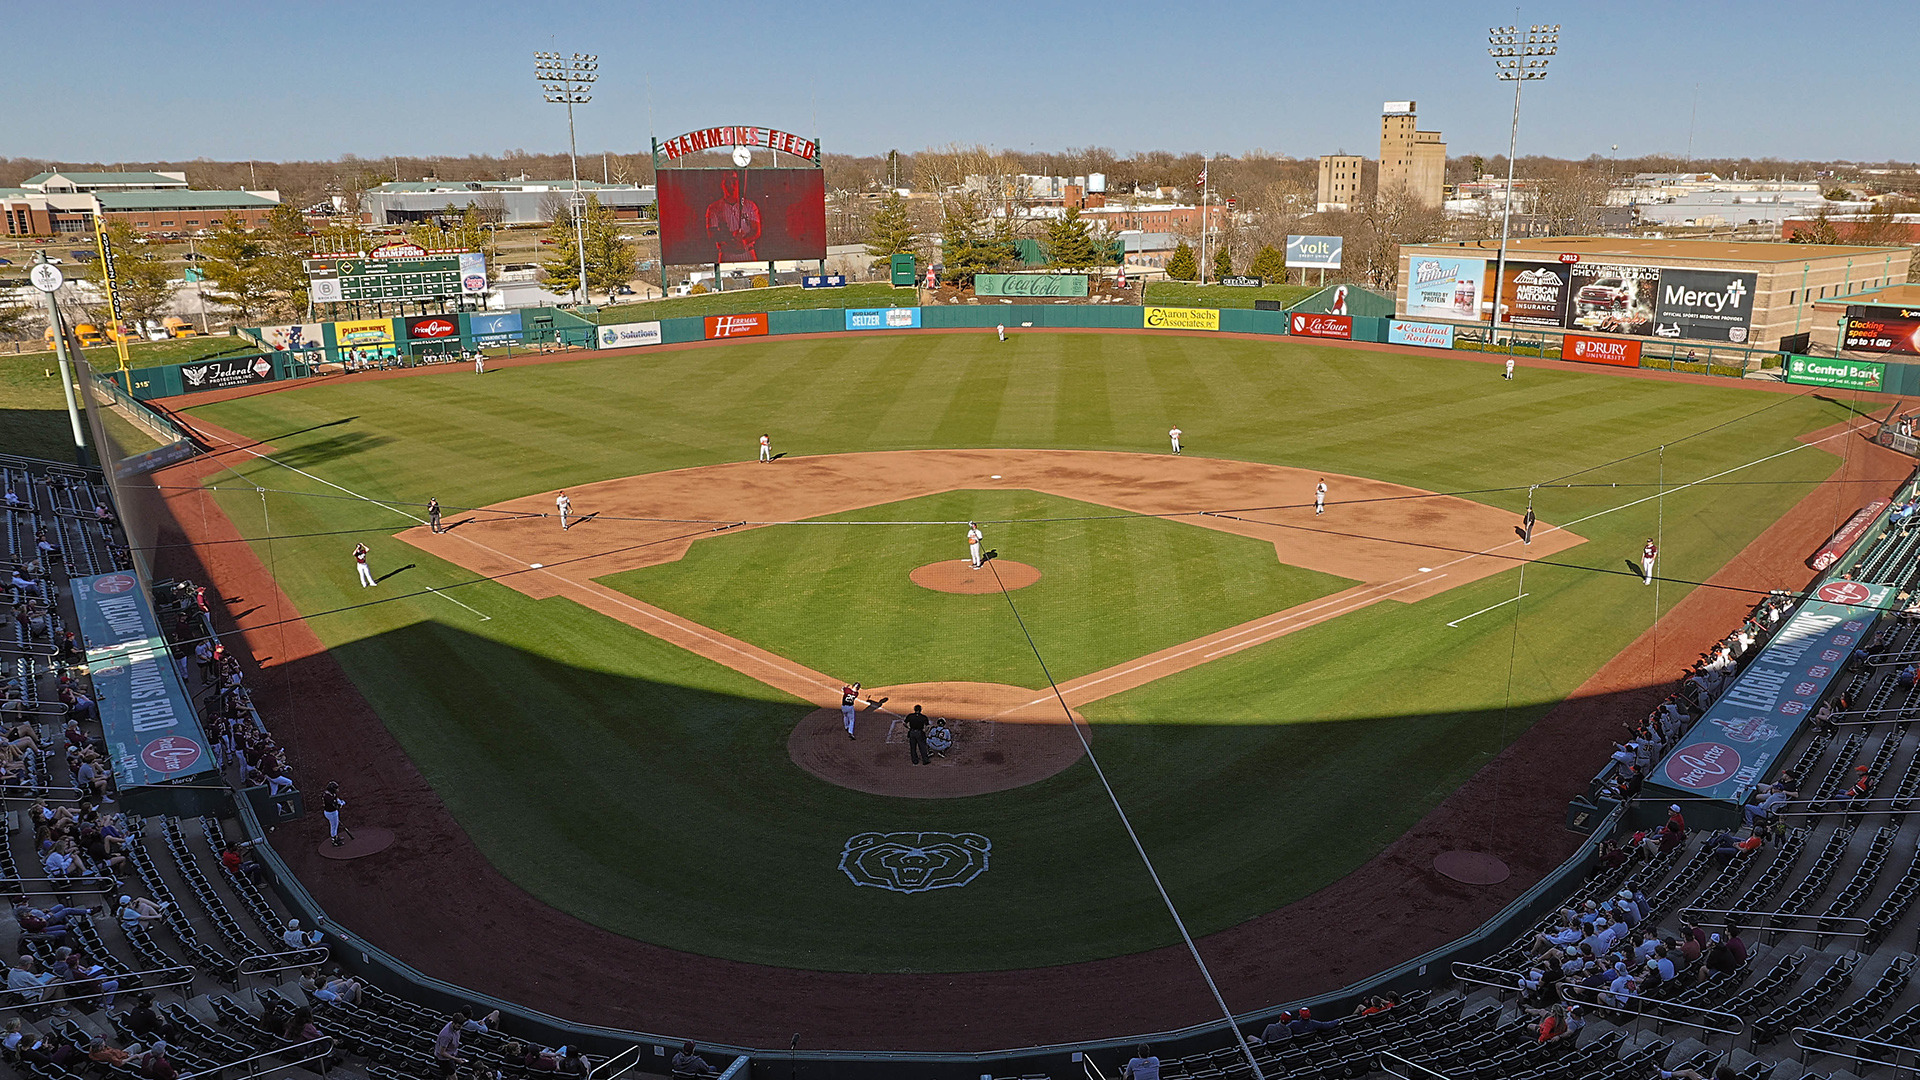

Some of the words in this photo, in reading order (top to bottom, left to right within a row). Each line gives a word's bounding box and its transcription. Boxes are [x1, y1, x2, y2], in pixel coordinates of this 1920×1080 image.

[663, 126, 759, 161] HAMMONS
[768, 129, 815, 160] FIELD
[372, 250, 424, 258] CHAMPIONS
[1300, 241, 1329, 254] volt
[1562, 254, 1578, 262] 2012
[1415, 264, 1460, 285] Hiland
[1572, 268, 1603, 278] CHEVY
[1605, 270, 1660, 281] SILVERADO
[1002, 275, 1063, 296] Coca-Cola
[1516, 284, 1559, 297] AMERICAN
[1516, 291, 1557, 303] NATIONAL
[1664, 284, 1730, 312] Mercy
[1515, 303, 1556, 311] INSURANCE
[852, 315, 880, 327] SELTZER
[1147, 308, 1164, 326] &
[1160, 309, 1188, 319] Aaron
[1190, 309, 1216, 320] Sachs
[730, 326, 750, 334] Lumber
[1403, 323, 1449, 336] Cardinal
[1849, 320, 1885, 331] Clocking
[620, 329, 658, 340] Solutions
[1403, 332, 1446, 346] Roofing
[1848, 329, 1878, 338] speeds
[1586, 341, 1628, 355] DRURY
[1846, 338, 1857, 346] up
[1858, 338, 1868, 346] to
[1869, 338, 1875, 347] 1
[1875, 339, 1892, 347] GIG
[1586, 353, 1627, 361] UNIVERSITY
[209, 359, 253, 379] Federal
[1807, 362, 1848, 378] Central
[1849, 366, 1880, 380] Bank
[96, 594, 145, 635] WELCOME
[1722, 665, 1791, 713] LEAGUE
[1760, 611, 1843, 667] CHAMPIONS
[127, 646, 167, 700] HAMMONS
[131, 698, 179, 733] FIELD
[171, 775, 194, 786] Mercy
